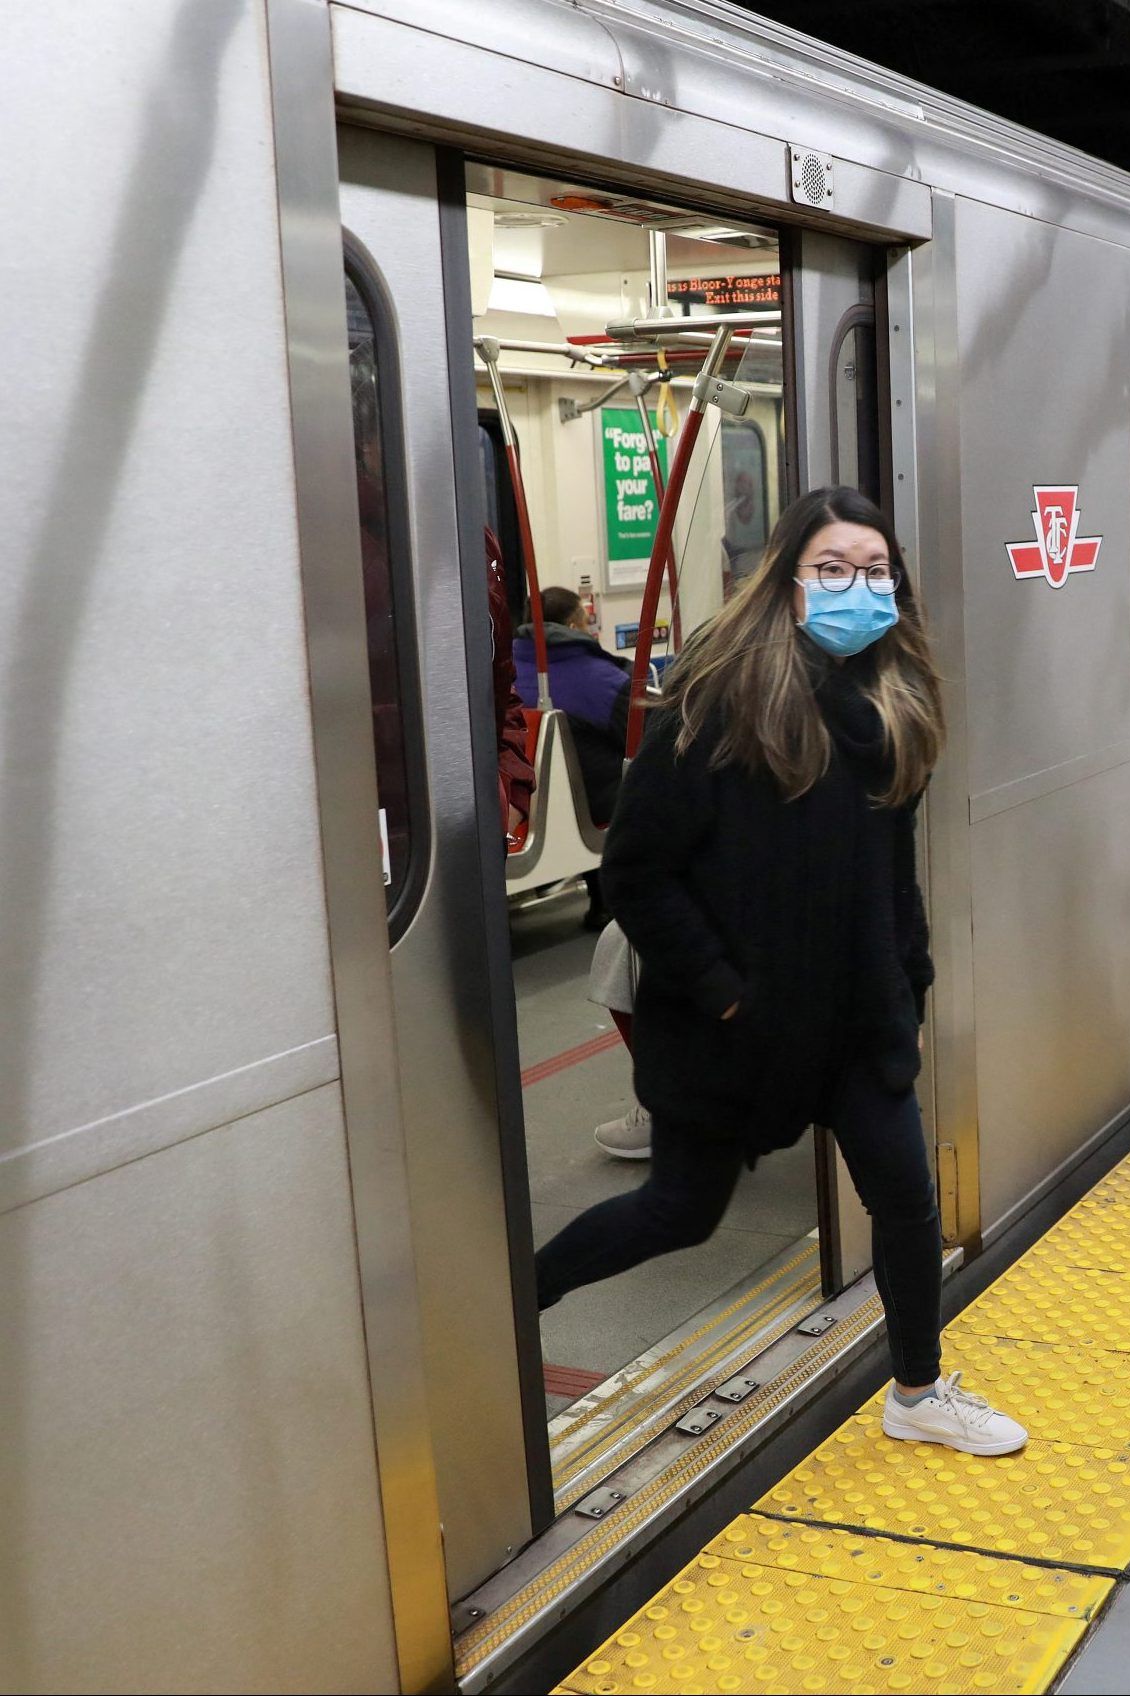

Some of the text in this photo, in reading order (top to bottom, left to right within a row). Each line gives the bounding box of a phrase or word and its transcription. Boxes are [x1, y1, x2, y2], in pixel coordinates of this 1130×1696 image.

[679, 282, 688, 292] is
[705, 288, 779, 305] Exit this side
[614, 451, 655, 477] to pa
[616, 479, 648, 501] your
[617, 500, 654, 522] fare?
